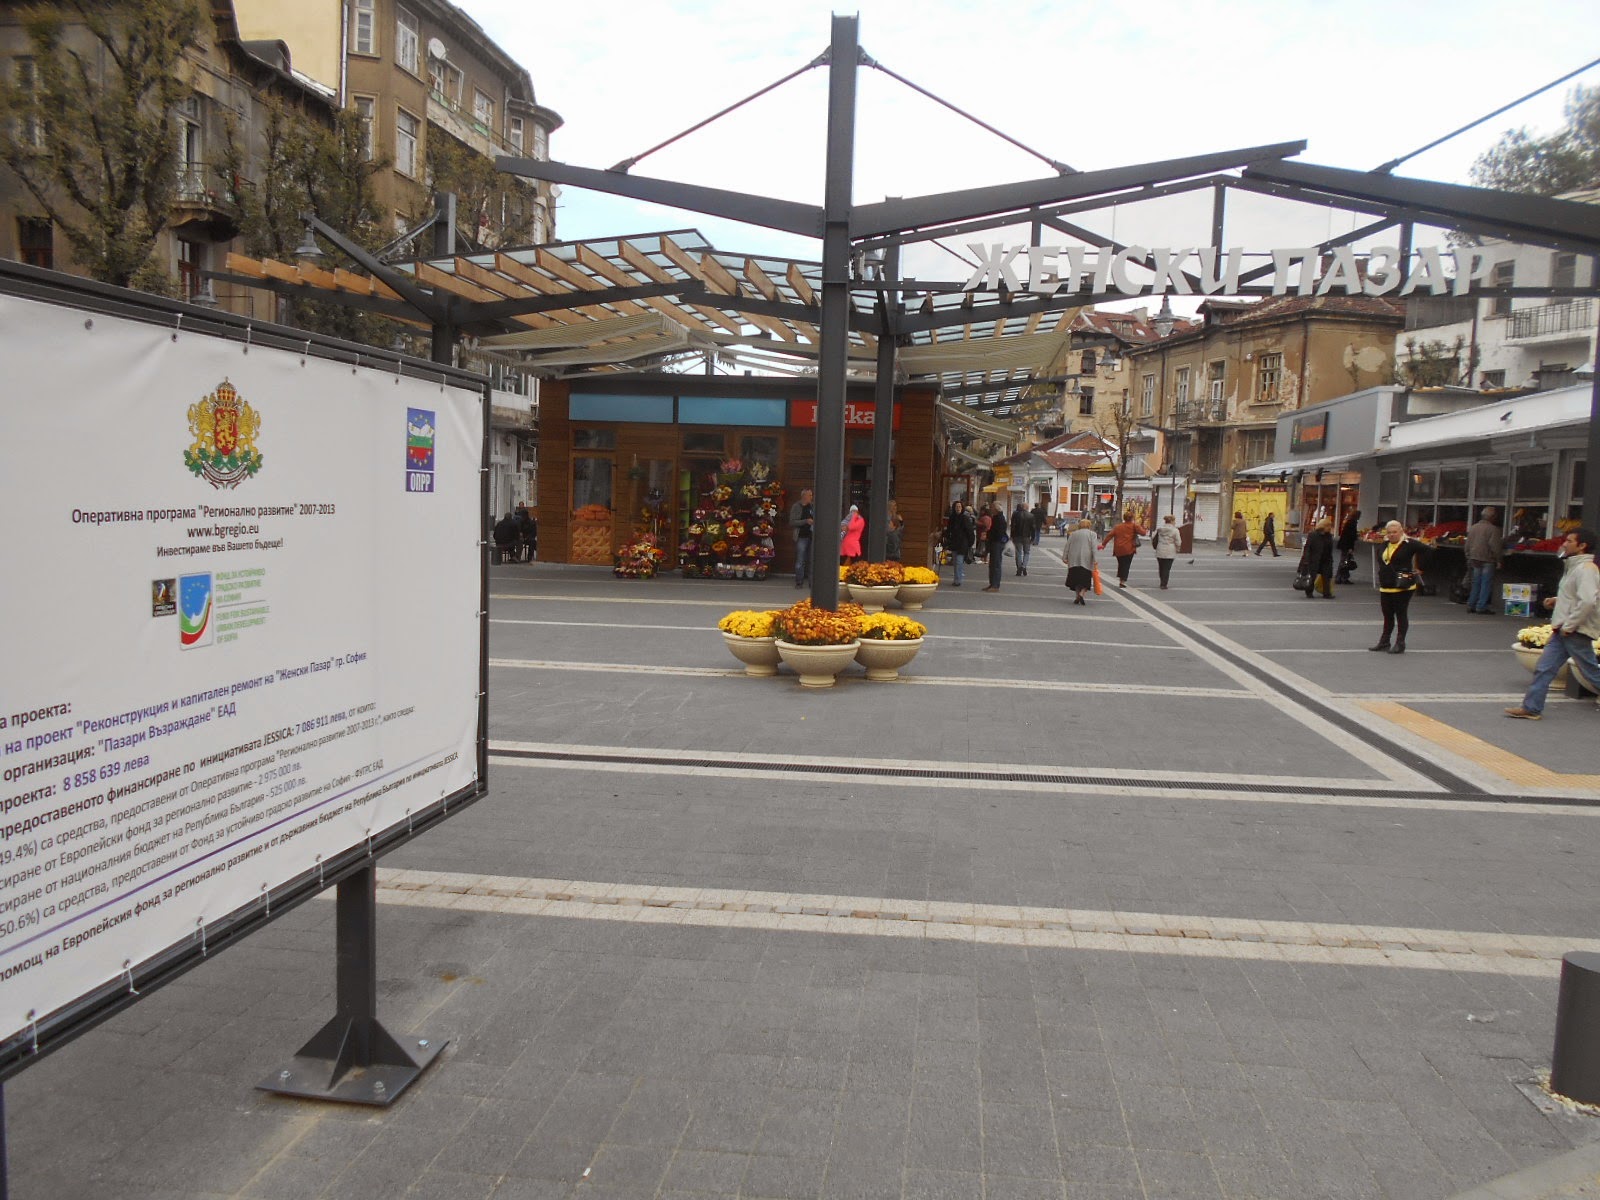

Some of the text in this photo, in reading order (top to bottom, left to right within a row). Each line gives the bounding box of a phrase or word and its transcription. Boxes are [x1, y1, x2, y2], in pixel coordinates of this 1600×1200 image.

[962, 243, 1495, 297] ЖЕНСКИ ПАЗАР
[811, 404, 876, 425] fka
[72, 503, 336, 526] Оперативна програма "Регионално развитие" 2007-2013
[410, 473, 431, 492] ОПРР
[157, 538, 283, 557] Инвестираме във Вашето бъдеще!
[187, 523, 259, 538] www.bgregio.eu
[5, 741, 22, 755] на
[26, 727, 73, 750] проект
[76, 702, 169, 734] "Реконструкция
[171, 699, 178, 710] и
[180, 686, 229, 708] капитален
[231, 677, 263, 696] ремонт
[264, 674, 274, 685] на
[276, 665, 309, 680] "Женски
[310, 657, 334, 673] Пазар"
[346, 652, 366, 664] София
[12, 703, 71, 728] проекта:
[4, 702, 236, 782] организация: "Пазари Възраждане" ЕАД
[63, 776, 71, 791] 8
[74, 768, 96, 788] 858
[100, 761, 120, 780] 639
[123, 755, 150, 773] лева
[107, 766, 181, 804] финансиране
[183, 762, 196, 775] по
[200, 739, 262, 768] инициативата
[263, 727, 294, 746] JESSICA:
[295, 724, 301, 735] 7
[302, 720, 315, 733] 086
[316, 715, 328, 728] 911
[348, 707, 356, 717] от
[41, 838, 54, 850] са
[56, 818, 108, 845] средства,
[111, 791, 177, 824] предоставени
[180, 786, 189, 797] от
[190, 768, 239, 792] Оперативна
[240, 755, 275, 774] програма
[319, 730, 345, 747] развитие
[44, 859, 57, 871] от
[60, 833, 123, 866] Европейски
[125, 821, 151, 842] фонд
[153, 816, 163, 828] за
[165, 795, 216, 825] регионално
[218, 780, 253, 804] развитие
[264, 769, 277, 783] 975
[43, 905, 56, 917] са
[58, 882, 109, 912] средства,
[111, 850, 178, 887] предоставени
[180, 844, 189, 856] от
[191, 833, 214, 849] Фонд
[216, 828, 224, 840] за
[226, 811, 265, 836] устойчиво
[265, 798, 292, 817] градско
[293, 786, 322, 806] развитие
[323, 782, 331, 792] на
[45, 881, 58, 895] от
[61, 850, 131, 888] националния
[133, 832, 171, 856] бюджет
[173, 827, 183, 839] на
[185, 808, 228, 834] Република
[230, 793, 265, 815] България
[45, 945, 60, 960] на
[62, 909, 132, 951] Европейския
[134, 894, 161, 916] фонд
[162, 887, 172, 901] за
[175, 862, 226, 897] регионално
[227, 844, 263, 871] развитие
[264, 841, 269, 850] и
[270, 838, 279, 847] от
[279, 817, 318, 844] държавния
[319, 806, 344, 824] бюджет
[344, 803, 352, 811] на
[353, 790, 382, 808] Република
